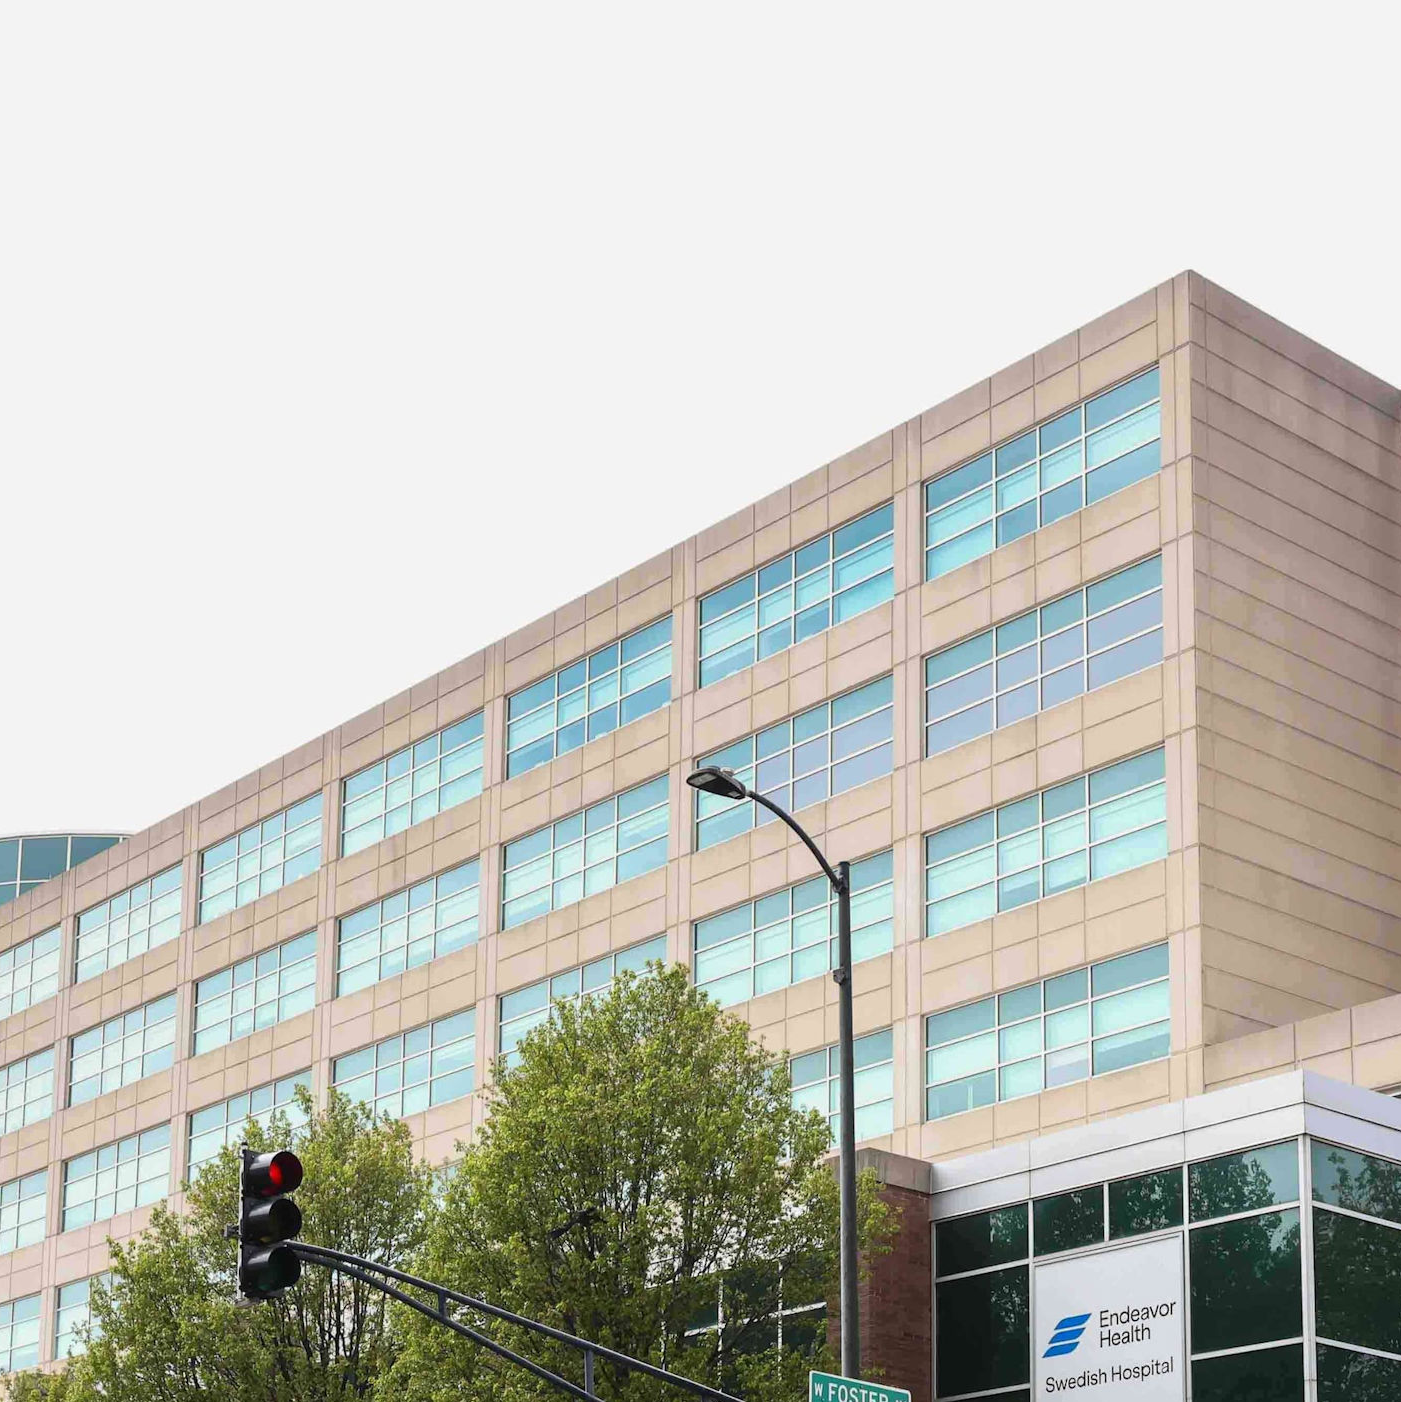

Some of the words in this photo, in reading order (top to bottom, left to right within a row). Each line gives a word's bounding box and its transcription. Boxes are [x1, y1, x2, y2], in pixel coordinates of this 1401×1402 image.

[1100, 1301, 1176, 1328] Endeavor
[1100, 1323, 1151, 1348] Health
[1045, 1368, 1107, 1393] Swedish
[1111, 1356, 1174, 1382] Hospital
[814, 1383, 823, 1397] W
